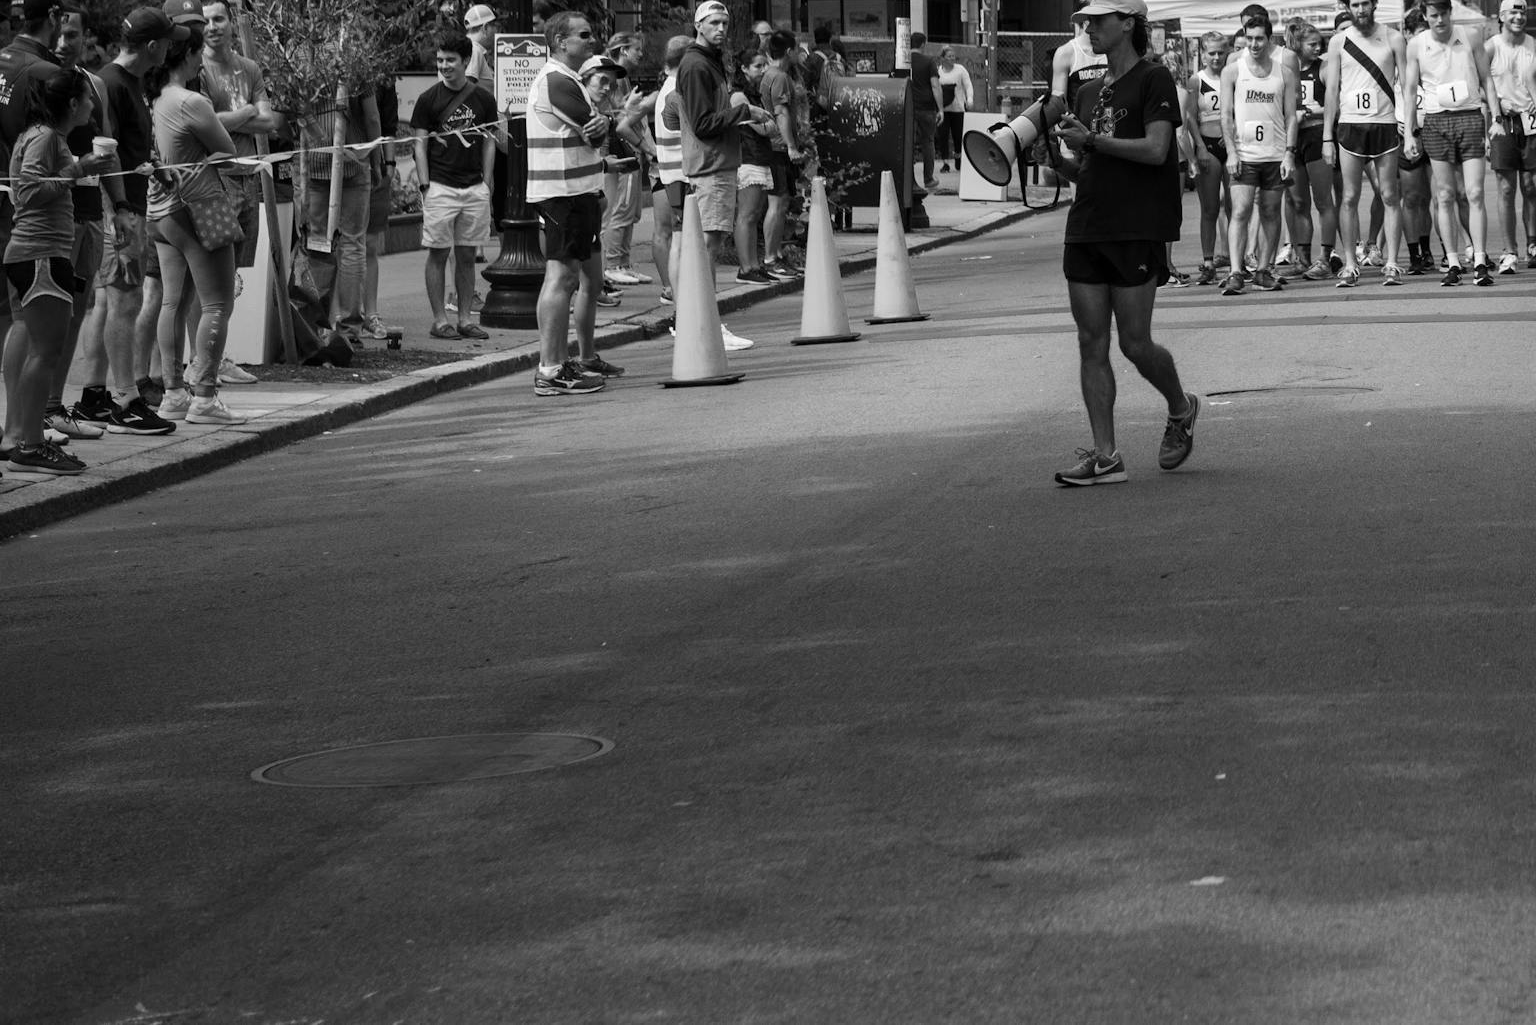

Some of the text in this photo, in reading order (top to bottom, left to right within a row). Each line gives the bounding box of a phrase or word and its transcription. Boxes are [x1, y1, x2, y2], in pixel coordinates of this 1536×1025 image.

[514, 59, 530, 67] NO
[1356, 93, 1370, 109] 18
[1450, 87, 1456, 102] 1
[1256, 125, 1264, 141] 6
